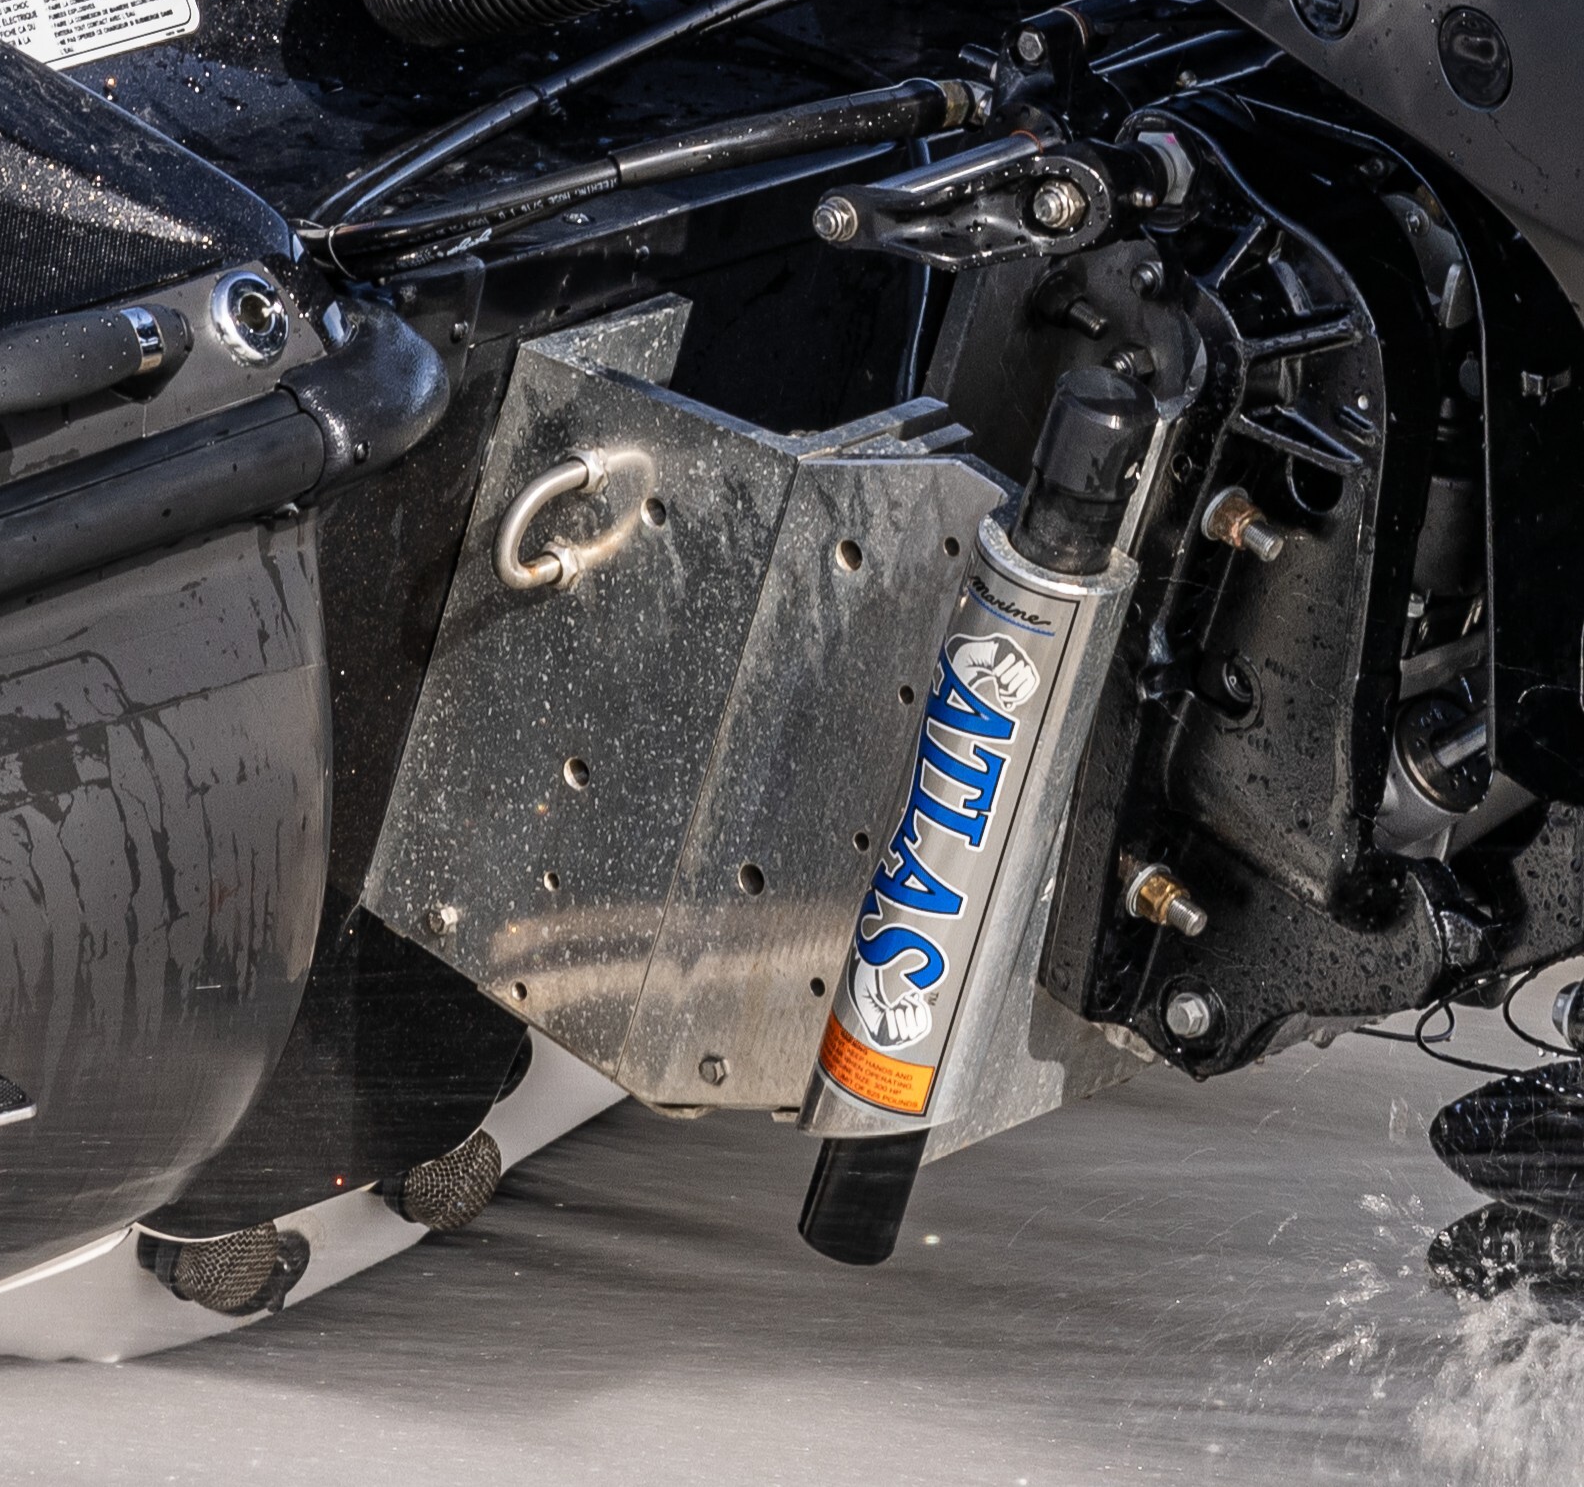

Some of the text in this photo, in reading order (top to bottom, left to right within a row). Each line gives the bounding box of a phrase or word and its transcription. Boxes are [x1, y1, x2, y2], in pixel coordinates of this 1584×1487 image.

[856, 636, 1017, 990] ATLAS
[865, 1057, 893, 1075] HANDS
[896, 1069, 913, 1081] AND
[882, 1093, 919, 1108] POUNDS
